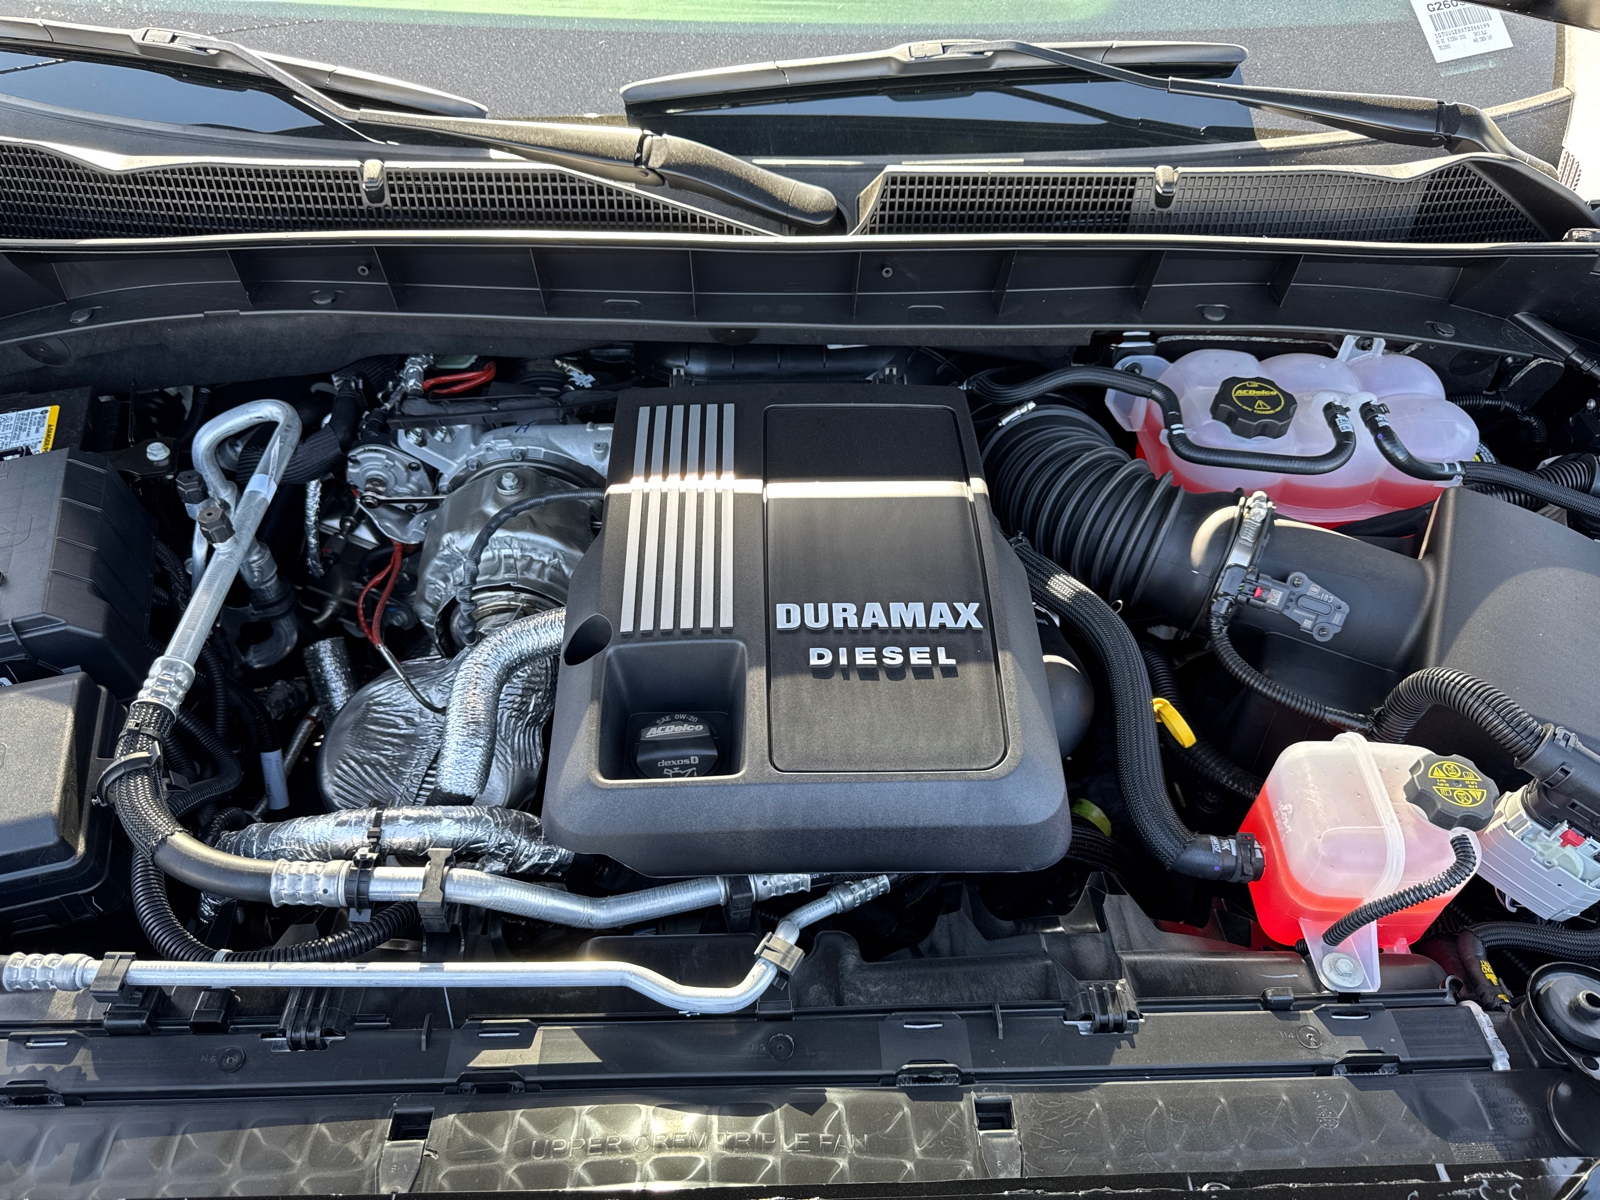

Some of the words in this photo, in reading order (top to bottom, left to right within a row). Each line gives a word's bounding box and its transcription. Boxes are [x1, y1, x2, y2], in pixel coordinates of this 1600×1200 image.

[776, 602, 983, 631] DURAMAX
[809, 646, 957, 668] DIESEL
[646, 724, 704, 738] ACDelco
[656, 716, 671, 725] SAE
[531, 1136, 622, 1160] UPPER
[717, 1132, 811, 1153] TRIPLE
[819, 1133, 870, 1153] FAN
